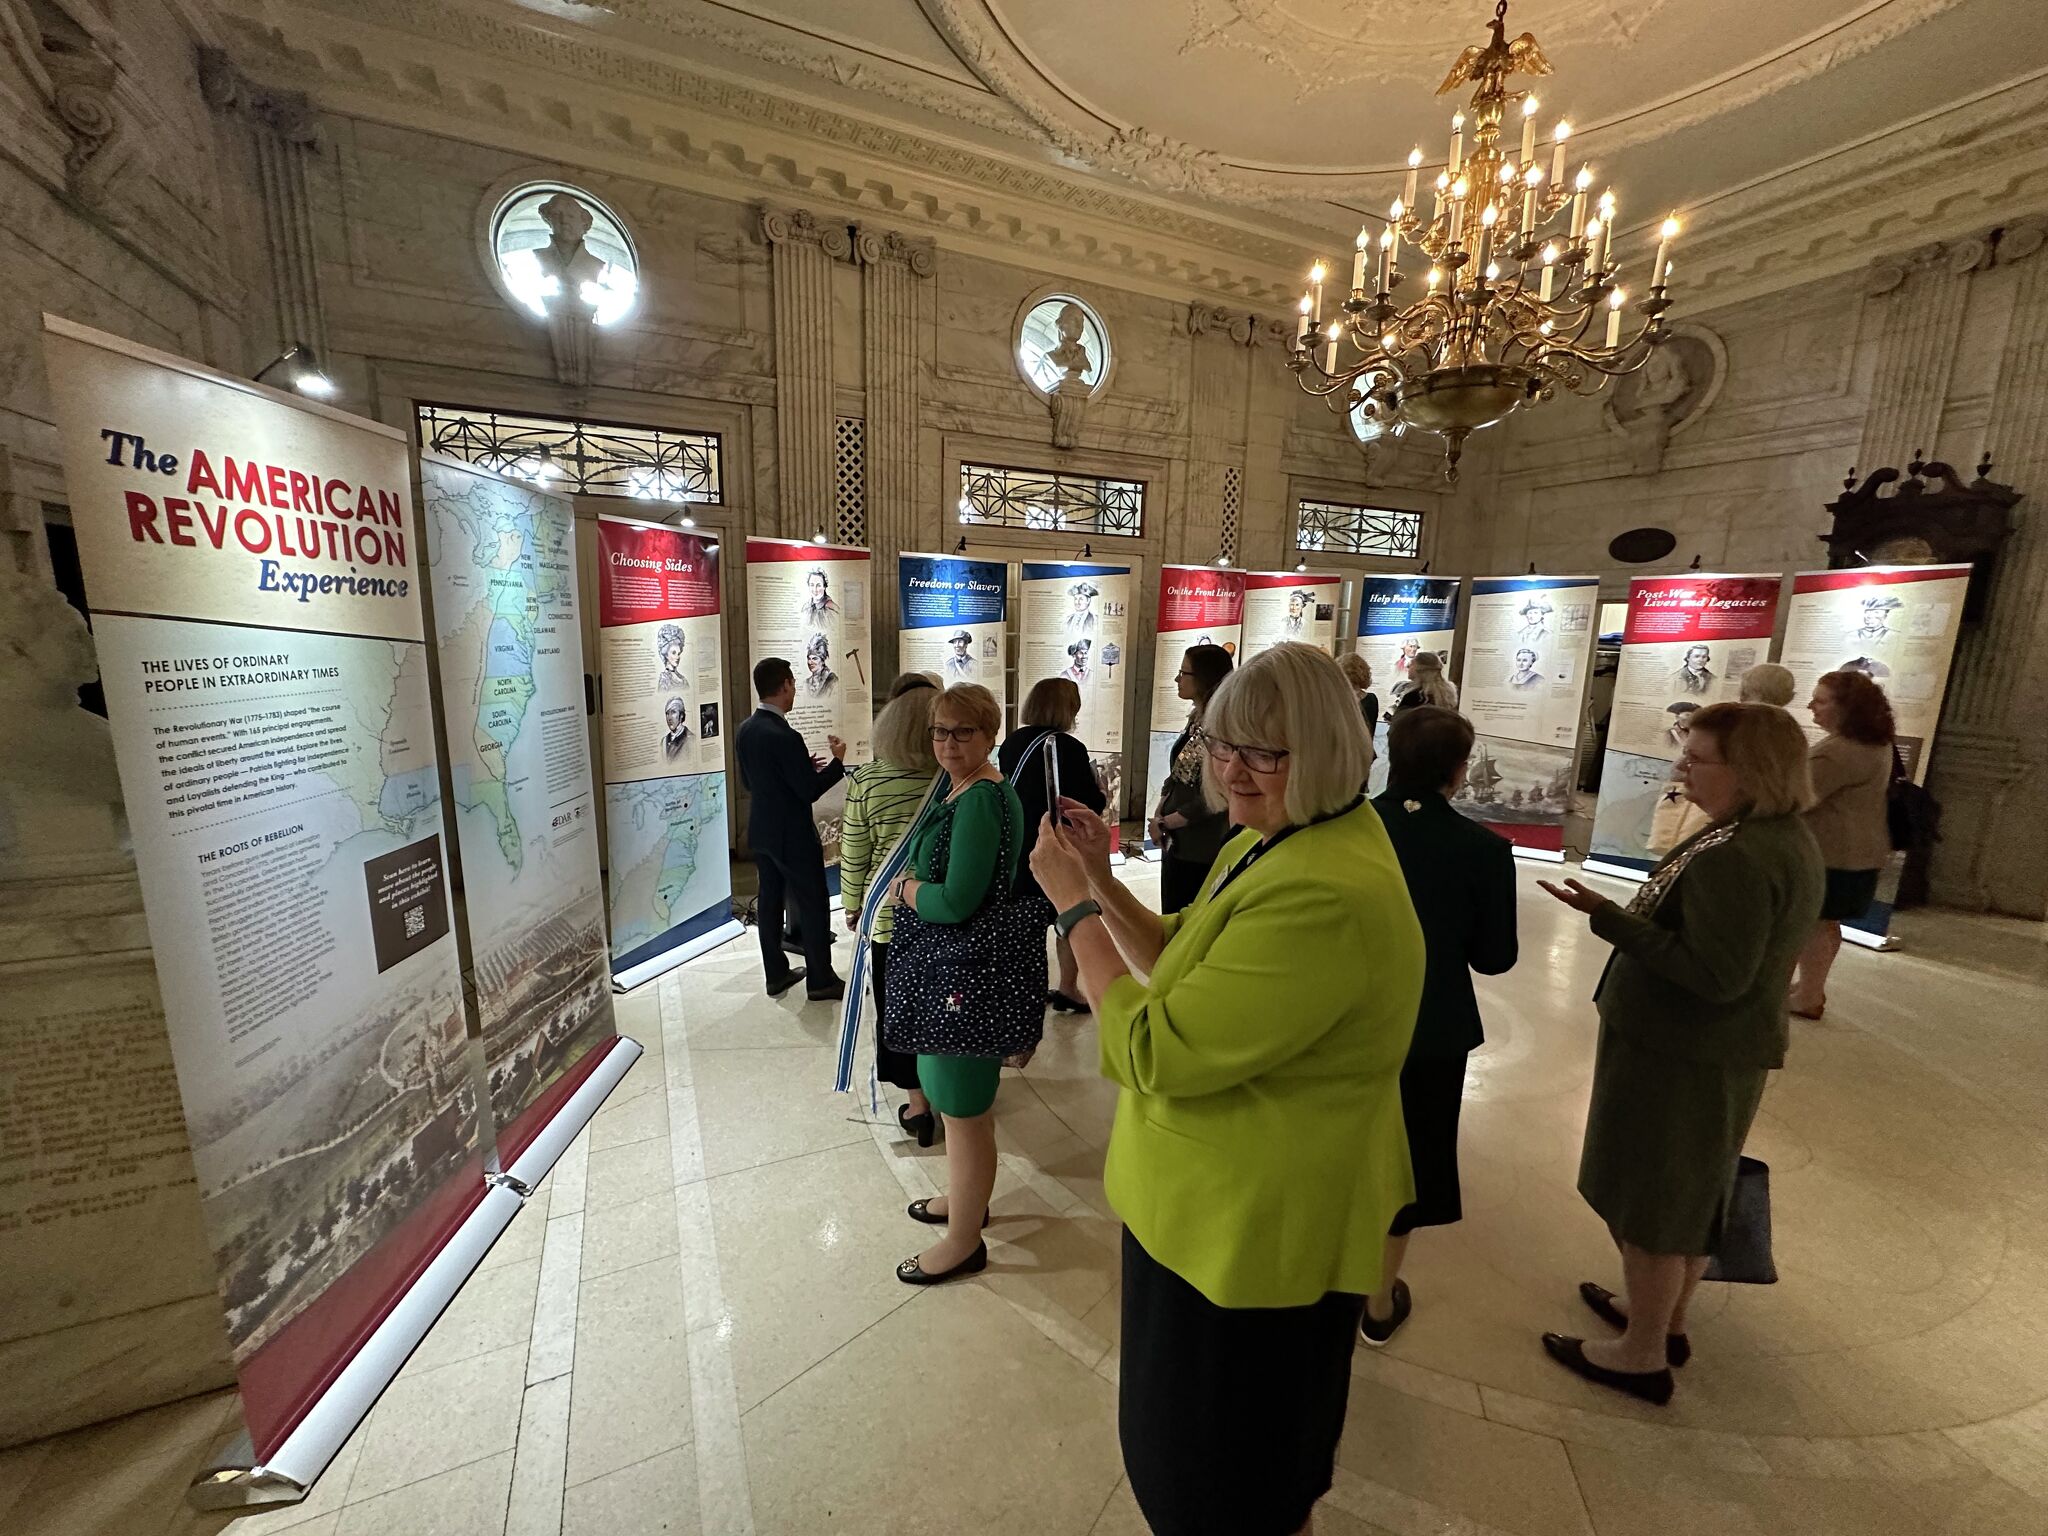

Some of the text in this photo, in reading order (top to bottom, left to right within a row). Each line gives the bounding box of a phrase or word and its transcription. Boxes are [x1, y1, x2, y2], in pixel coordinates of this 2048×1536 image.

[101, 428, 402, 528] The AMERICAN
[124, 490, 406, 567] REVOLUTION
[611, 552, 692, 573] Choosing Sides
[258, 559, 408, 602] Experience
[909, 577, 952, 589] Freedom
[968, 580, 1001, 593] Slavery
[1168, 587, 1236, 597] On the Front Lines
[1636, 589, 1697, 599] Post-War
[1369, 594, 1450, 605] Help From Abroad
[1644, 597, 1767, 609] Lives and Legacies
[495, 645, 514, 653] VIRGINIA
[141, 654, 289, 673] THE LIVES OF ORDINARY
[145, 667, 339, 693] PEOPLE IN EXTRAORDINARY TIMES
[497, 678, 512, 686] NORTH
[494, 687, 516, 696] CAROLINA
[492, 710, 506, 718] SOUTH
[488, 718, 512, 728] CAROLINA
[156, 741, 165, 749] of
[168, 738, 199, 747] human
[233, 729, 247, 737] With
[262, 722, 290, 734] principal
[291, 717, 333, 728] engagements,
[176, 749, 206, 761] conflict
[207, 744, 237, 755] secured
[238, 739, 269, 750] American
[270, 732, 314, 743] independence
[315, 728, 327, 736] and
[327, 725, 347, 734] spread
[480, 741, 503, 752] GEORGIA
[198, 824, 304, 863] THE ROOTS OF REBELLION
